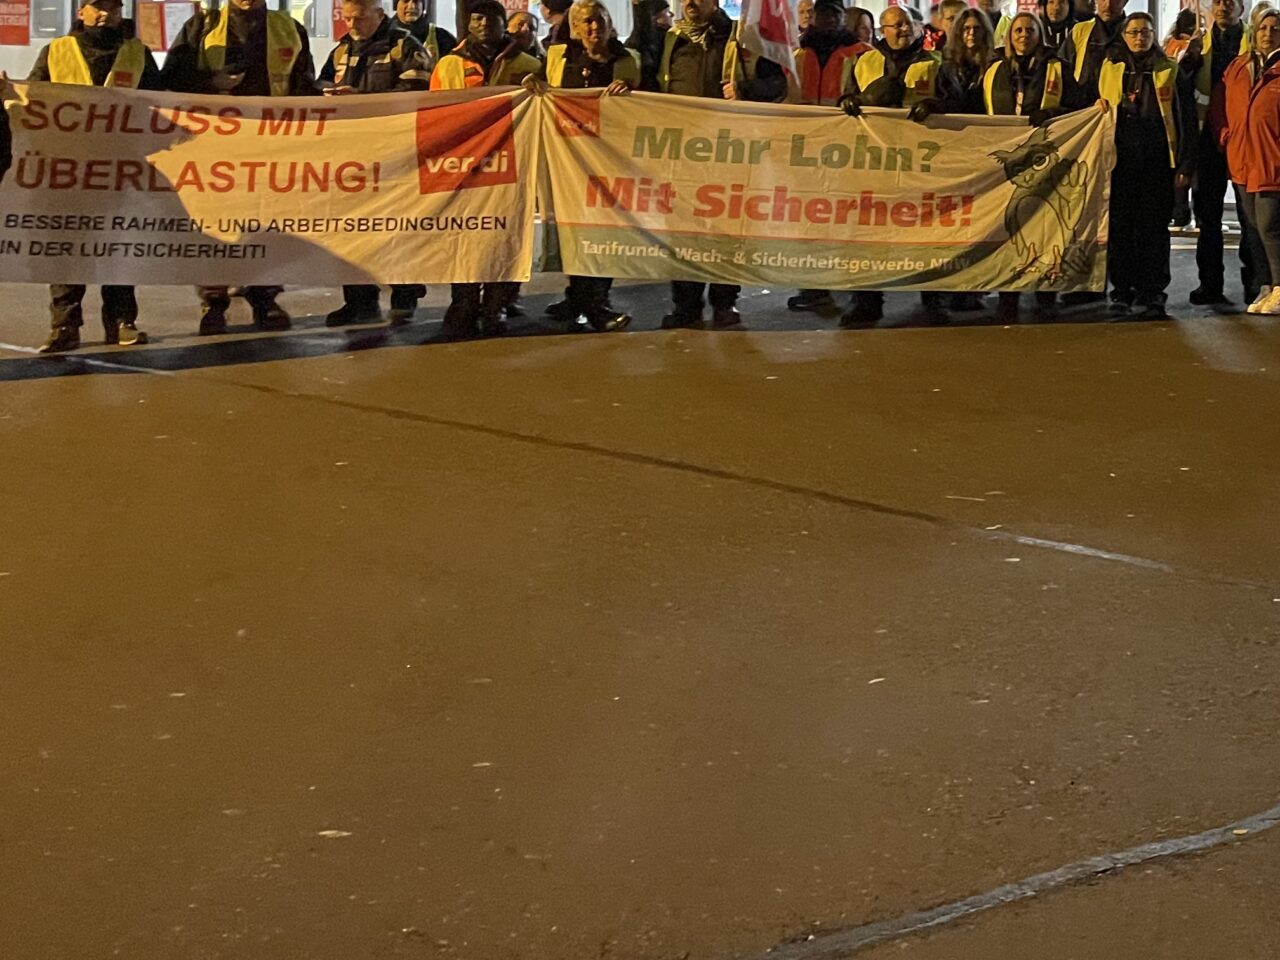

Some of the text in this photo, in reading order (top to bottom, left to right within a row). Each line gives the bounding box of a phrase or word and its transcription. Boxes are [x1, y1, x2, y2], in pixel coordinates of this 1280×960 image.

[21, 99, 337, 137] SCHLUSS MIT
[632, 125, 942, 173] Mehr Lohn?
[16, 150, 381, 193] ÜBERLASTUNG!
[585, 174, 976, 229] Mit Sicherheit!
[5, 213, 507, 234] BESSERE RAHMEN- UND ARBEITSBEDINGUNGEN
[0, 239, 22, 255] IN
[29, 240, 74, 257] DER
[581, 240, 669, 259] Tarifrunde
[675, 247, 728, 264] Wach-
[733, 251, 747, 265] &
[751, 252, 925, 274] Sicherheitsgewerbe
